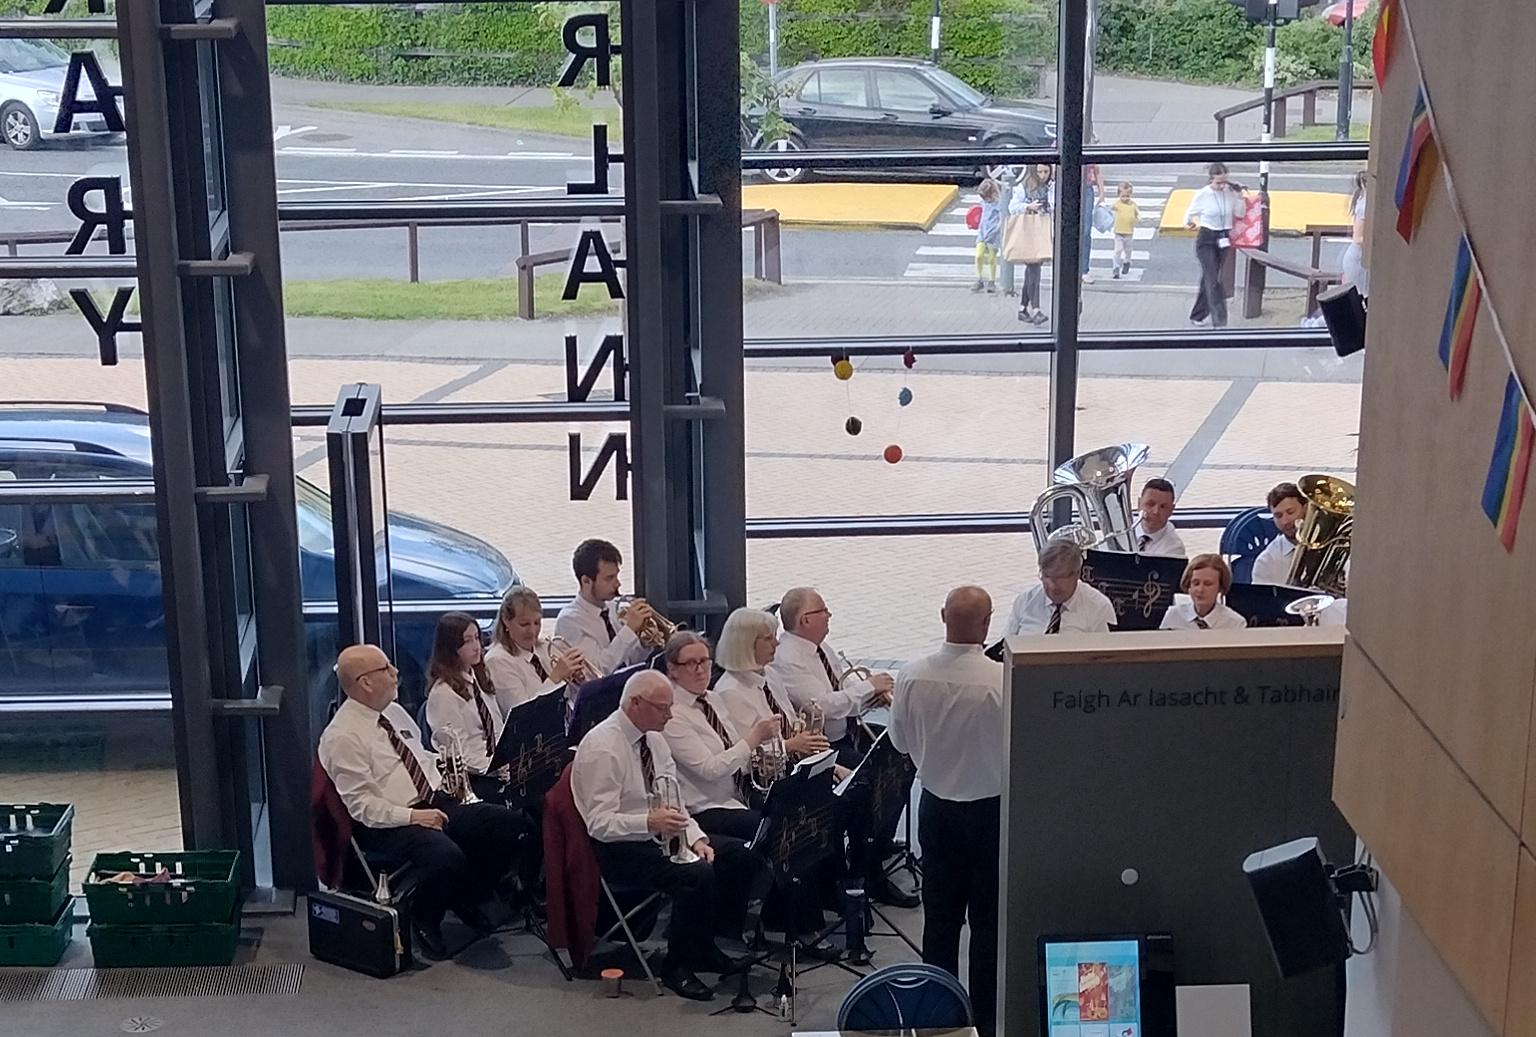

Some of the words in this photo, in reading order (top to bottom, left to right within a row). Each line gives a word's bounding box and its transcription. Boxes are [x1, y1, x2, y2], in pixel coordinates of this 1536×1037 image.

[1052, 688, 1110, 713] Faigh
[1117, 689, 1143, 707] Ar
[1233, 685, 1250, 705] &
